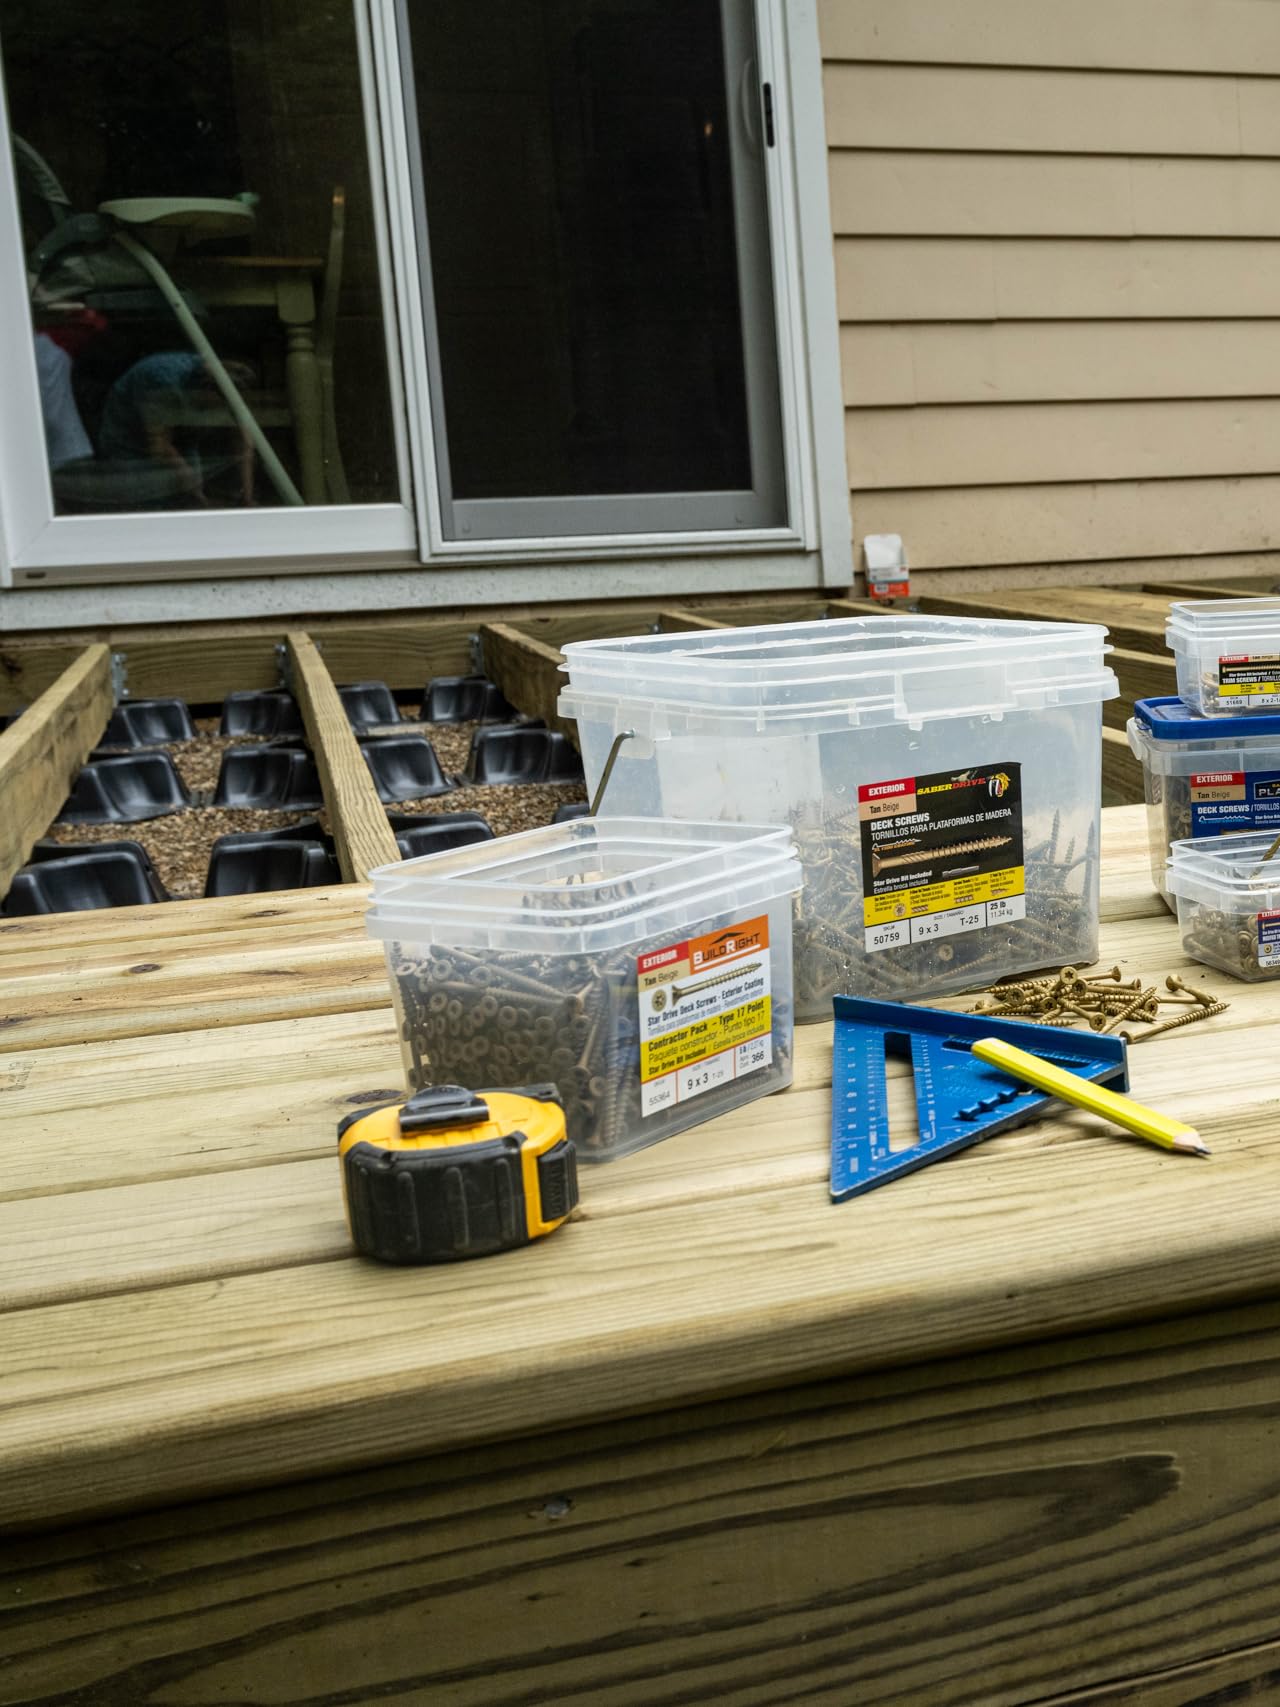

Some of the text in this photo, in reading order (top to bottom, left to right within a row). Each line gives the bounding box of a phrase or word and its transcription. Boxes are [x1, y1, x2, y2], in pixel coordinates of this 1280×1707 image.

[868, 778, 986, 796] EXTERIOR SABERDRIVE
[1197, 774, 1232, 783] EXTERIOR
[869, 803, 900, 814] Tan Beige
[1219, 805, 1250, 813] SCREWS
[1254, 803, 1280, 812] TORNILLOS
[871, 813, 930, 831] DECK SCREWS
[871, 808, 1012, 841] TORNILLOS PARA PLATAFORMAS DE MADERA
[873, 879, 885, 887] Star
[886, 876, 900, 884] Drive
[909, 870, 932, 880] Included
[874, 879, 928, 895] Estrella broca incluida
[919, 926, 924, 935] 9
[934, 923, 939, 932] 3
[960, 914, 979, 926] T-25
[874, 933, 900, 945] 50759
[643, 949, 678, 968] EXTERIOR
[644, 970, 679, 986] Tan Beige
[648, 977, 764, 1026] Star Drive Deck Screws Exterior Coating
[648, 1000, 764, 1052] Contractor Pack Type 17 Point
[648, 1012, 765, 1064] Paquete constructor Punto tipo 17
[648, 1066, 660, 1075] Star
[661, 1060, 675, 1070] Drive
[685, 1048, 706, 1061] Included
[752, 1051, 764, 1064] 366
[688, 1079, 693, 1090] 9
[695, 1079, 700, 1087] x
[703, 1073, 709, 1084] 3
